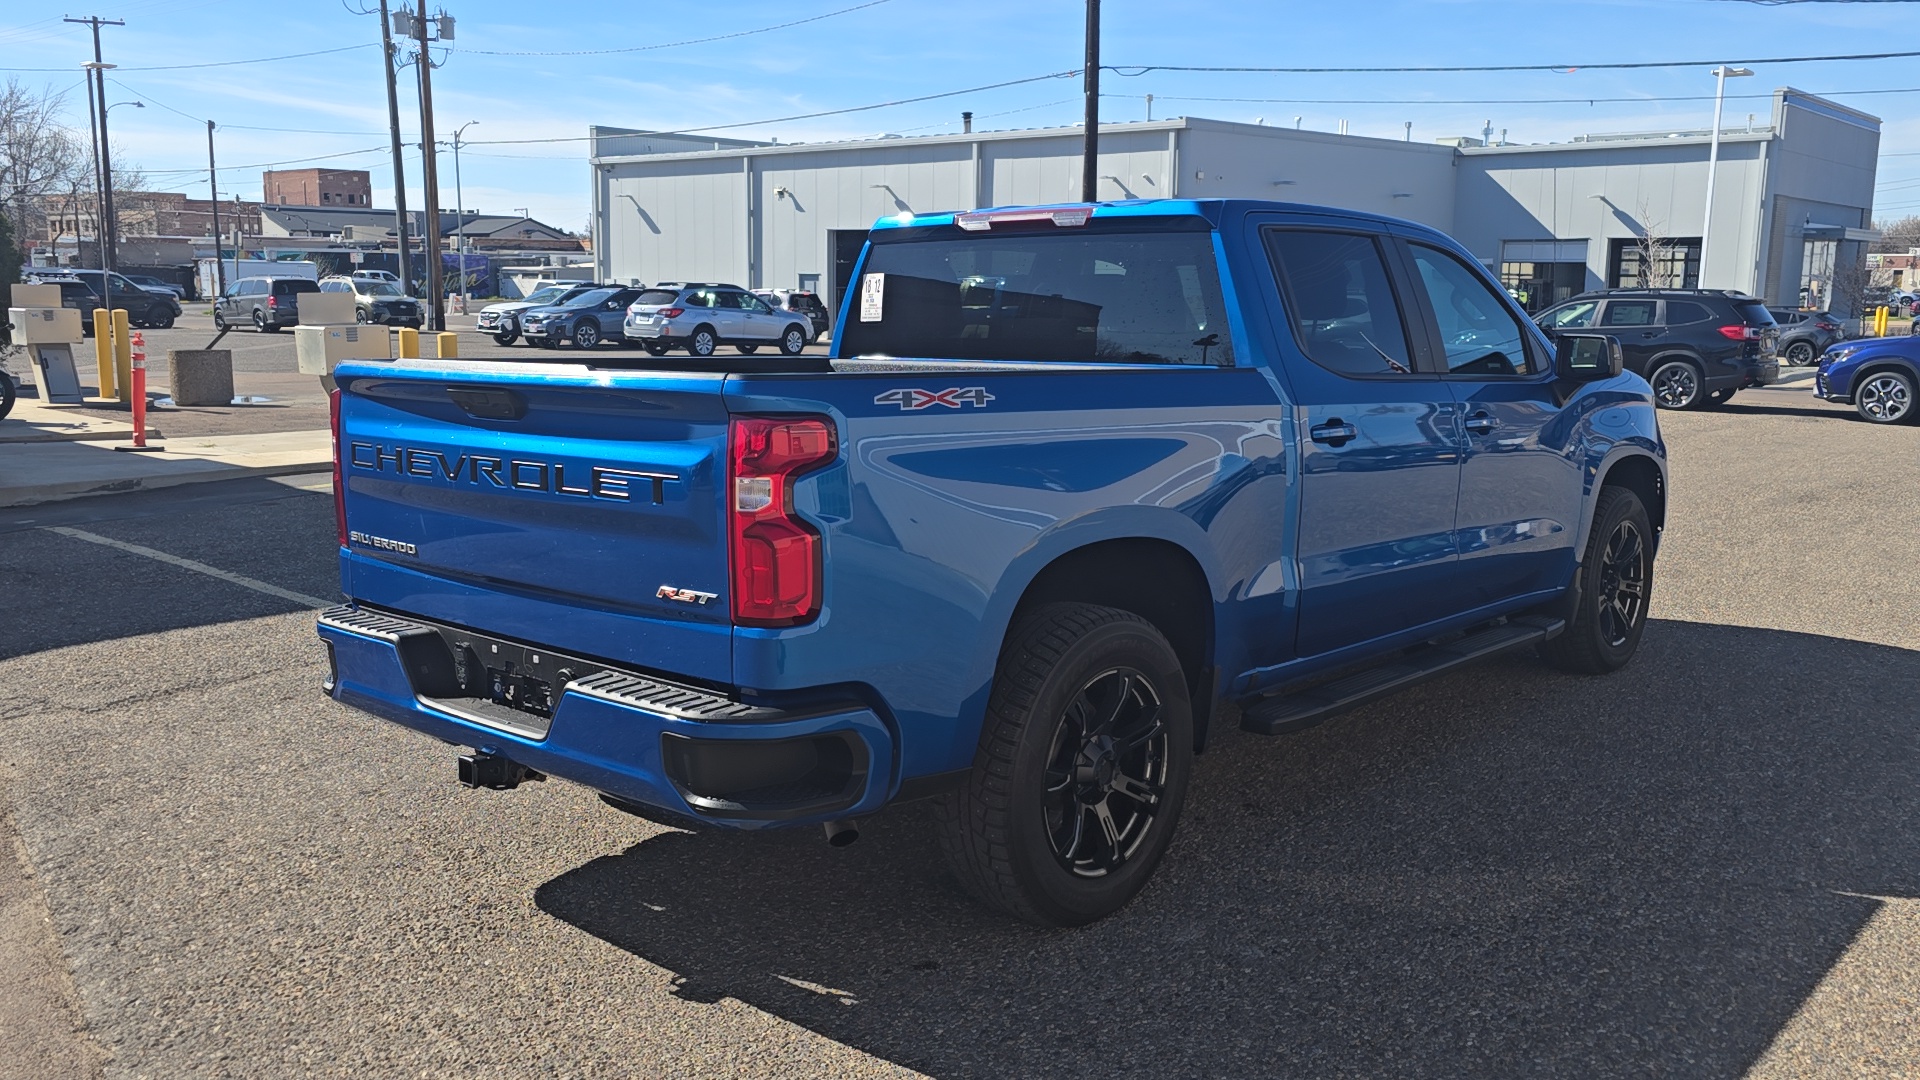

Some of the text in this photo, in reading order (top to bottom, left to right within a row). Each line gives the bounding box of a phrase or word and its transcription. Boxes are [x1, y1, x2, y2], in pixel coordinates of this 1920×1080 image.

[351, 441, 679, 506] CHEVROLET
[350, 530, 416, 554] SILVERADO
[656, 585, 719, 604] RST
